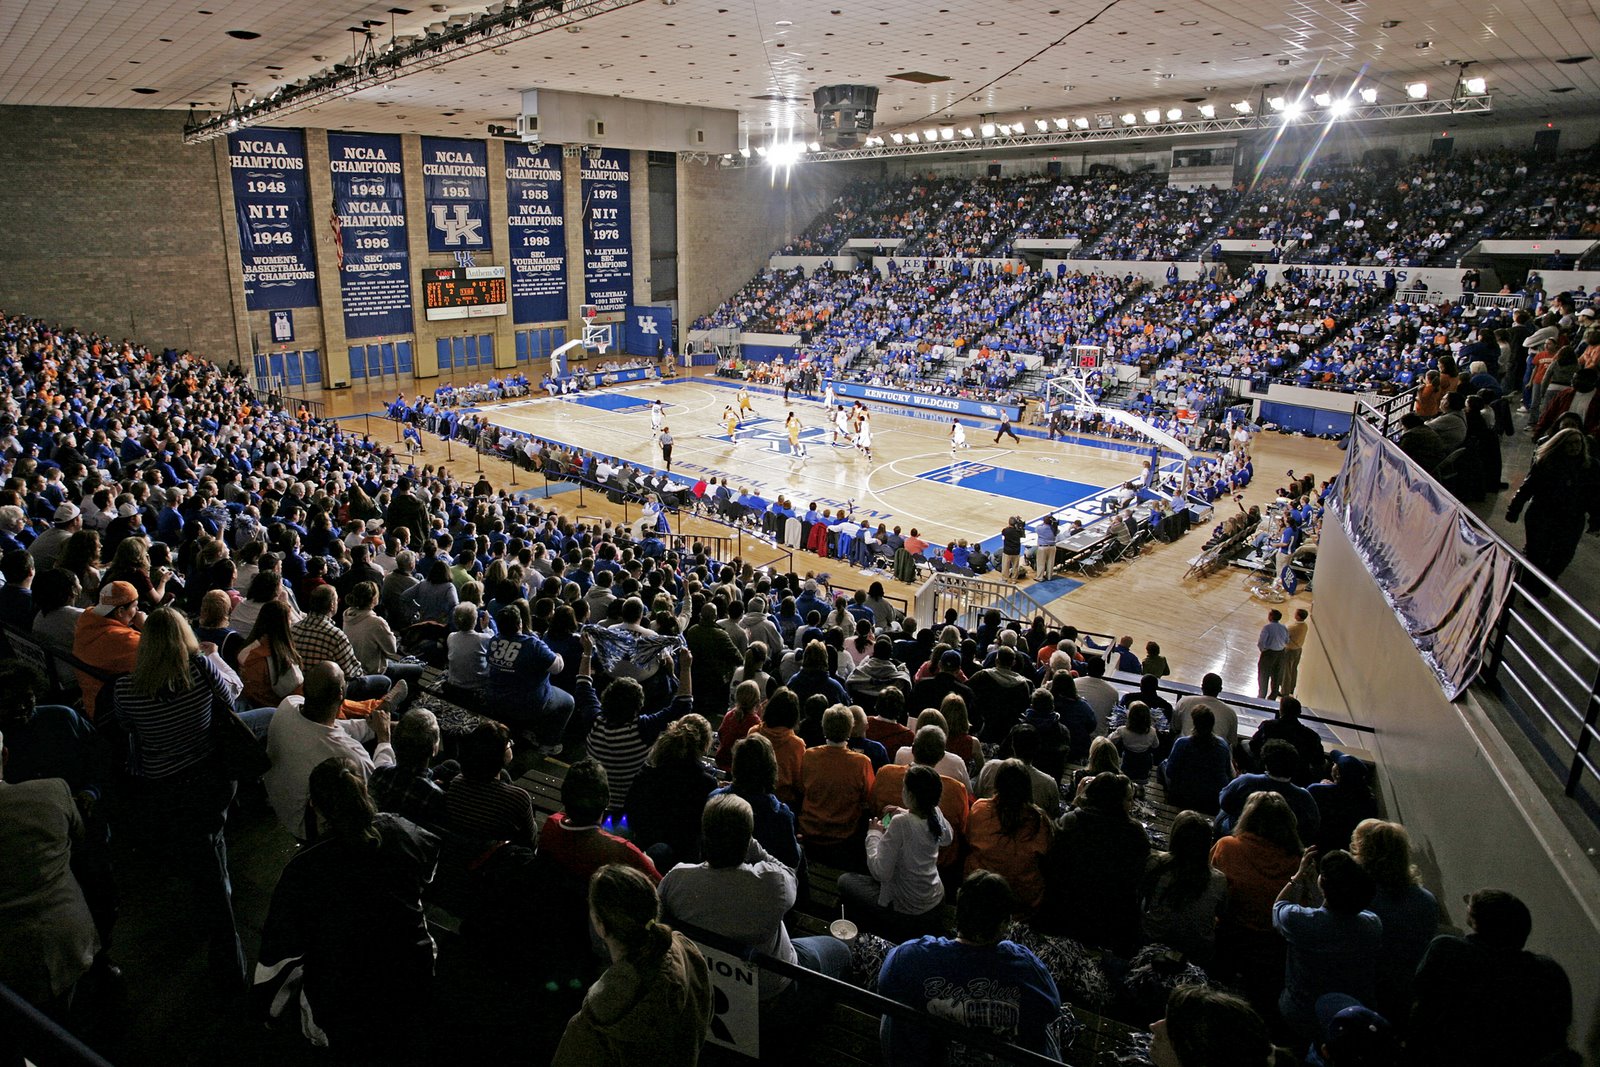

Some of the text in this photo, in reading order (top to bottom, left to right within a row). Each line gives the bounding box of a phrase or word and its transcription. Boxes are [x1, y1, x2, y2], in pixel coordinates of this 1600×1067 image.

[239, 140, 288, 155] NCAA
[343, 147, 388, 160] NCAA
[230, 155, 304, 170] HAMPIONS
[435, 151, 474, 164] NCAA
[516, 156, 551, 169] NCAA
[330, 161, 401, 174] CHAMPIONS
[589, 159, 620, 170] NCAA
[423, 164, 486, 178] CHAMPIONS
[505, 169, 562, 181] CHAMPIONS
[581, 170, 629, 182] CHAMPIONS
[248, 181, 287, 194] 1948
[351, 184, 385, 196] 1949
[442, 186, 471, 197] 1951
[521, 189, 549, 200] 1958
[593, 190, 618, 200] 1978
[248, 205, 289, 219] NIT
[348, 202, 391, 214] NCAA
[519, 204, 553, 215] NCAA
[592, 208, 618, 220] NIT
[337, 215, 405, 227] CHAMPIONS
[431, 204, 483, 245] UK
[507, 215, 563, 226] CHAMPIONS
[253, 231, 293, 245] 1946
[593, 229, 620, 240] 1976
[355, 238, 389, 249] 1996
[523, 236, 550, 246] 1998
[585, 248, 629, 256] VLLEYBALL
[363, 255, 383, 263] SEC
[512, 257, 564, 266] TOURNAMENT
[587, 261, 627, 269] CHAMPIONS
[245, 264, 307, 273] BASKETBALL
[345, 262, 402, 272] CHAMPIONS
[516, 264, 561, 272] CHAMPIONS
[243, 271, 315, 282] EC CHAMPIONS
[596, 303, 627, 311] HAMPION
[1080, 355, 1096, 368] 28
[864, 388, 911, 403] KENTUCKY
[913, 395, 959, 410] WILDCATS
[493, 639, 522, 662] 36
[703, 955, 753, 986] ION
[922, 976, 966, 1008] Big
